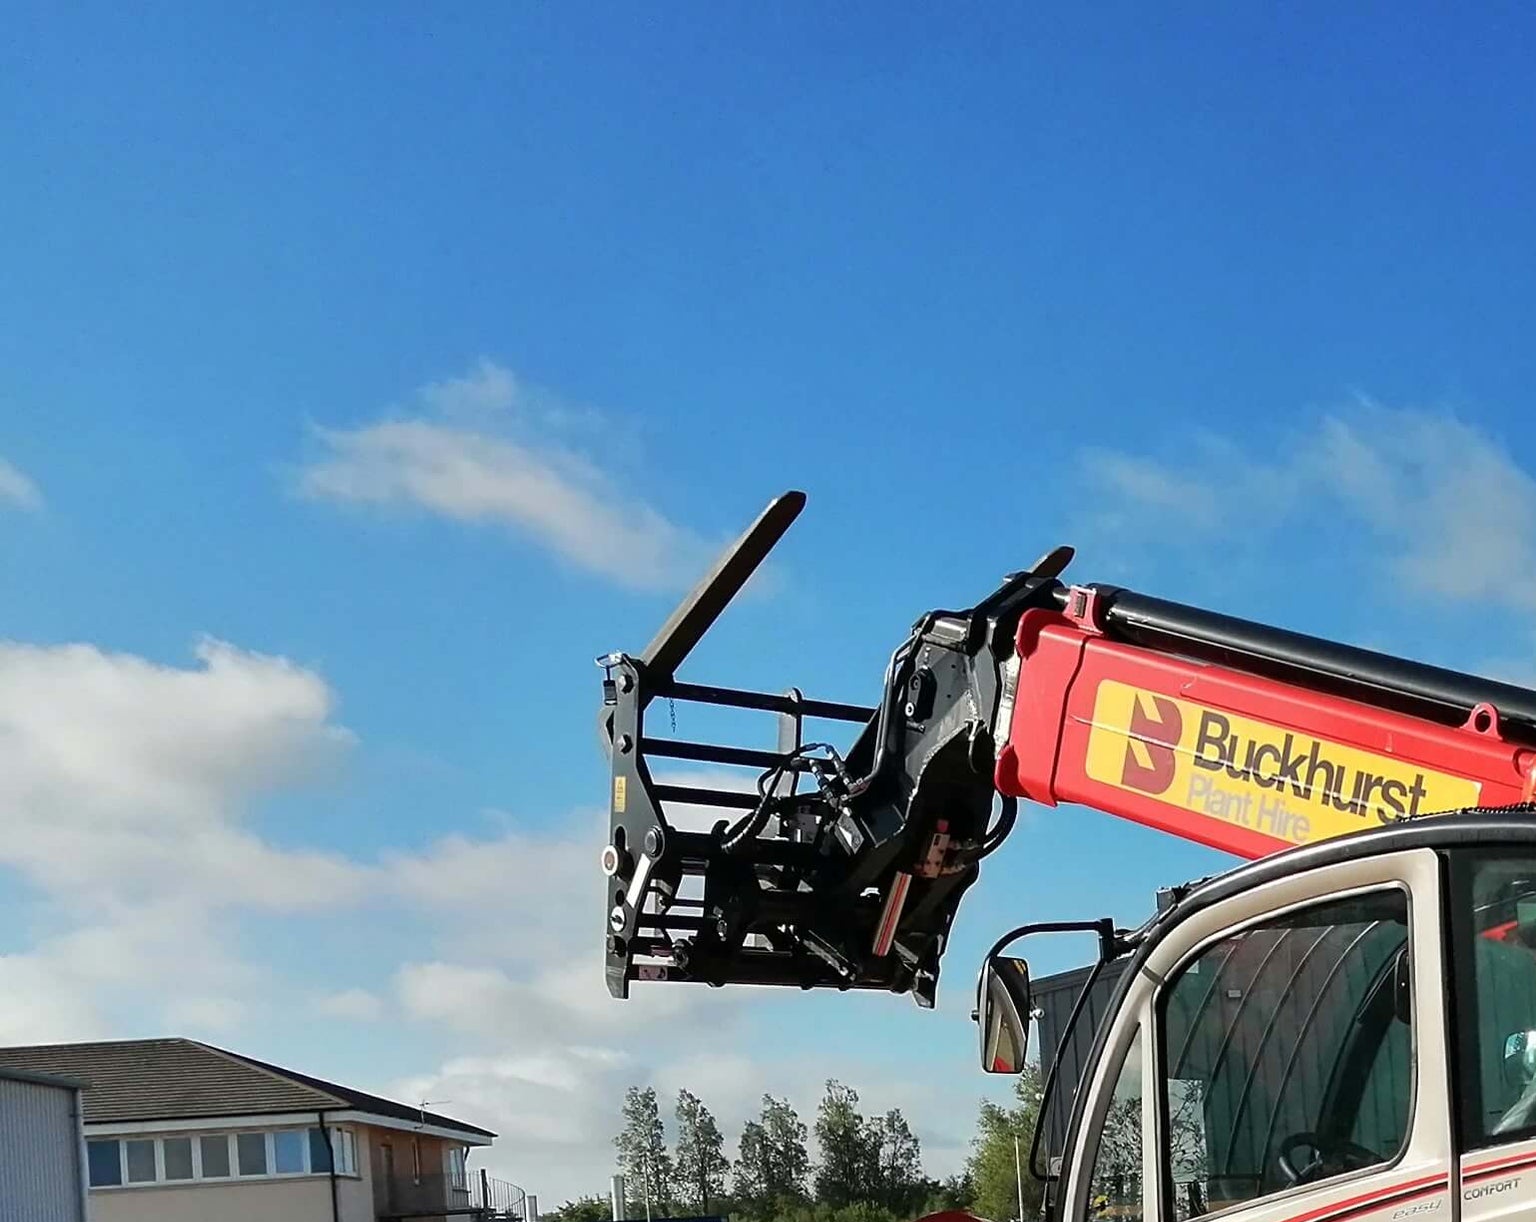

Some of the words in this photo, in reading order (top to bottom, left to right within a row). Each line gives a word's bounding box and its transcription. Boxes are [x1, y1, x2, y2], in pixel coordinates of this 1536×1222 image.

[1193, 709, 1427, 824] Buckhurst
[1187, 773, 1253, 824] Plant
[1257, 796, 1311, 842] Hire
[1463, 1178, 1521, 1201] COMFORT
